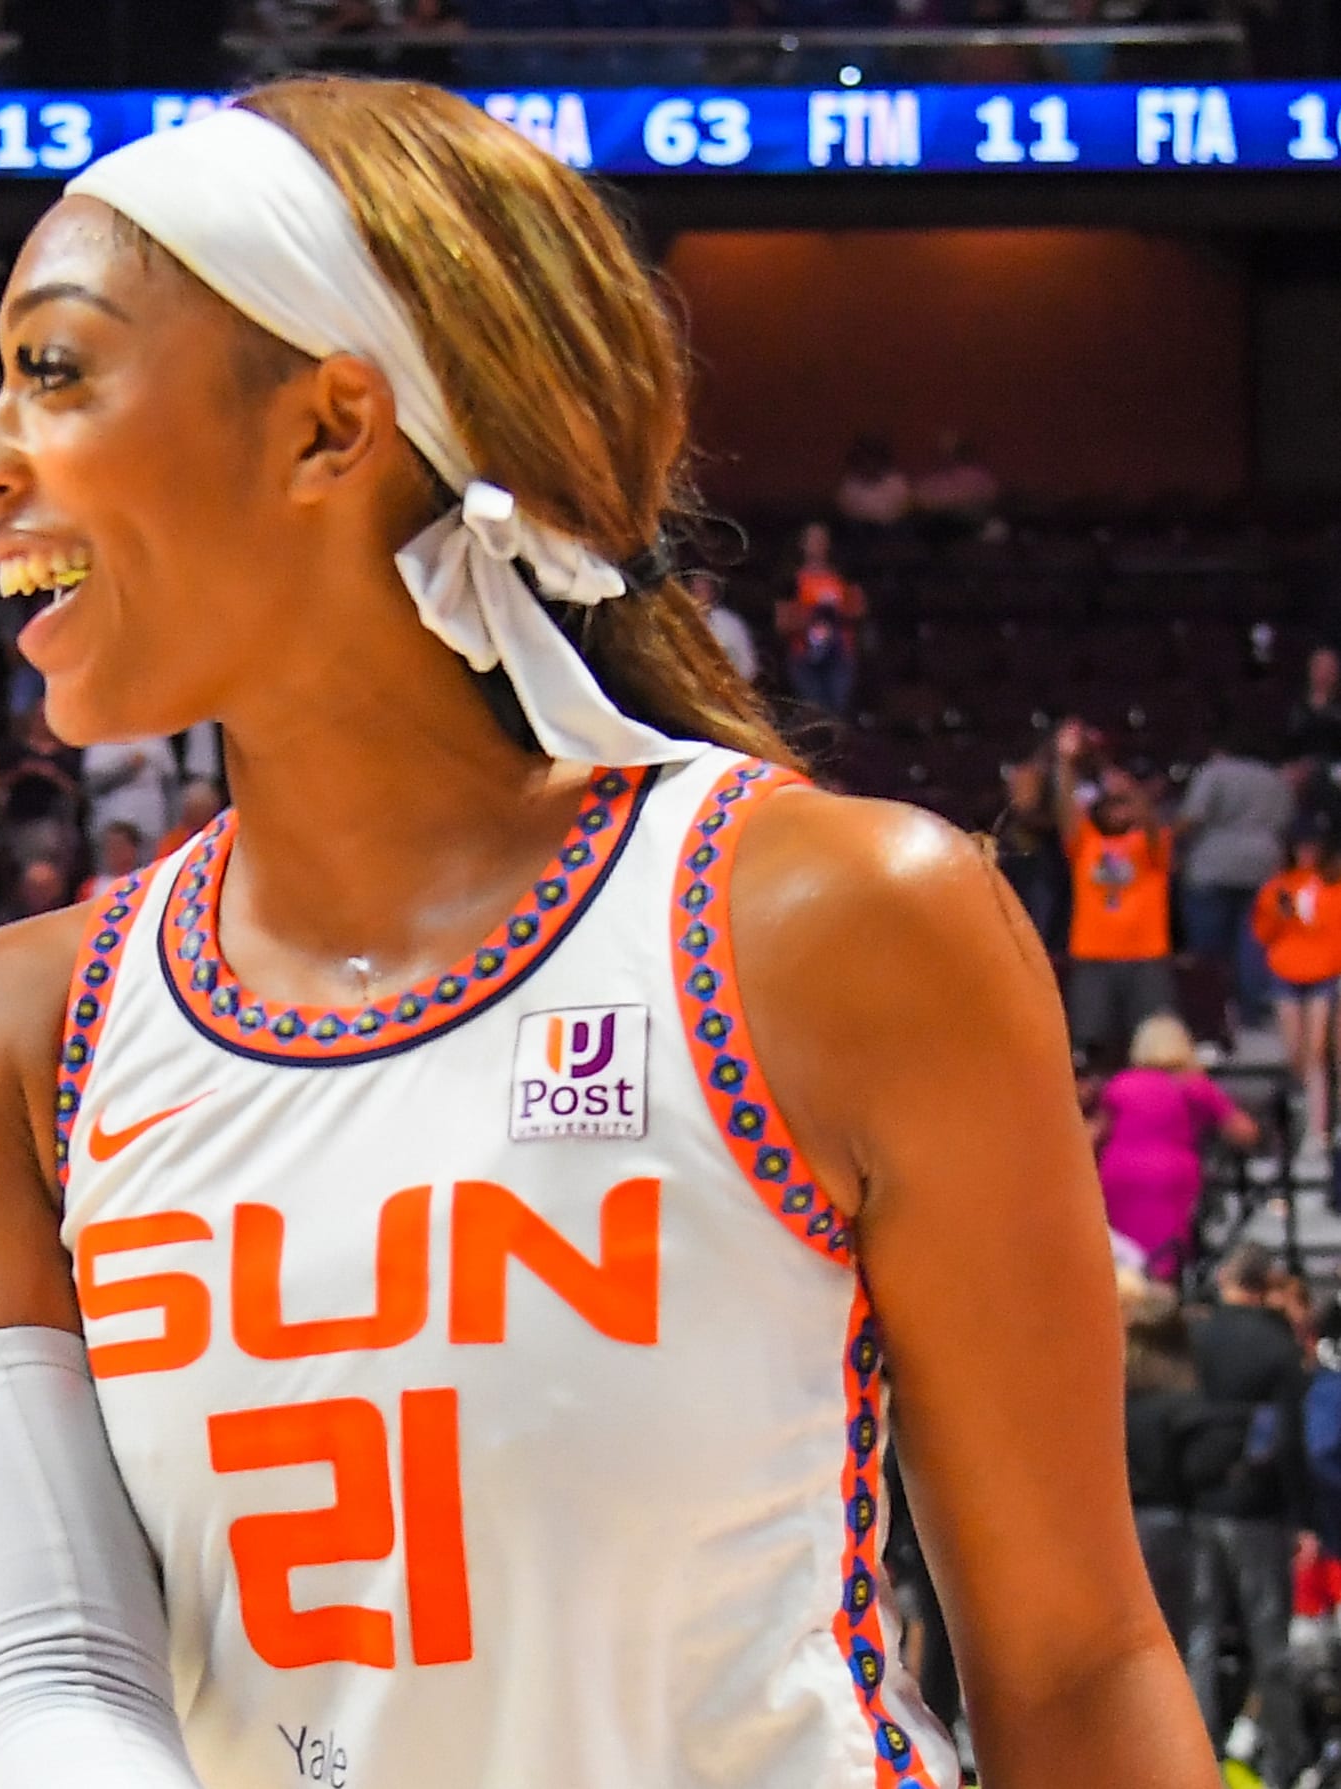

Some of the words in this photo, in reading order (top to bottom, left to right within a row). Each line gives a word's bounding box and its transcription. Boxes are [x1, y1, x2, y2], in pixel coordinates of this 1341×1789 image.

[644, 98, 751, 166] 63
[808, 91, 921, 167] FTM
[976, 95, 1079, 163] 11
[1136, 88, 1237, 165] FTA
[1288, 93, 1341, 160] 1
[520, 1078, 635, 1118] Post
[76, 1177, 662, 1380] SUN
[207, 1386, 475, 1671] 21
[277, 1724, 347, 1789] Yale
